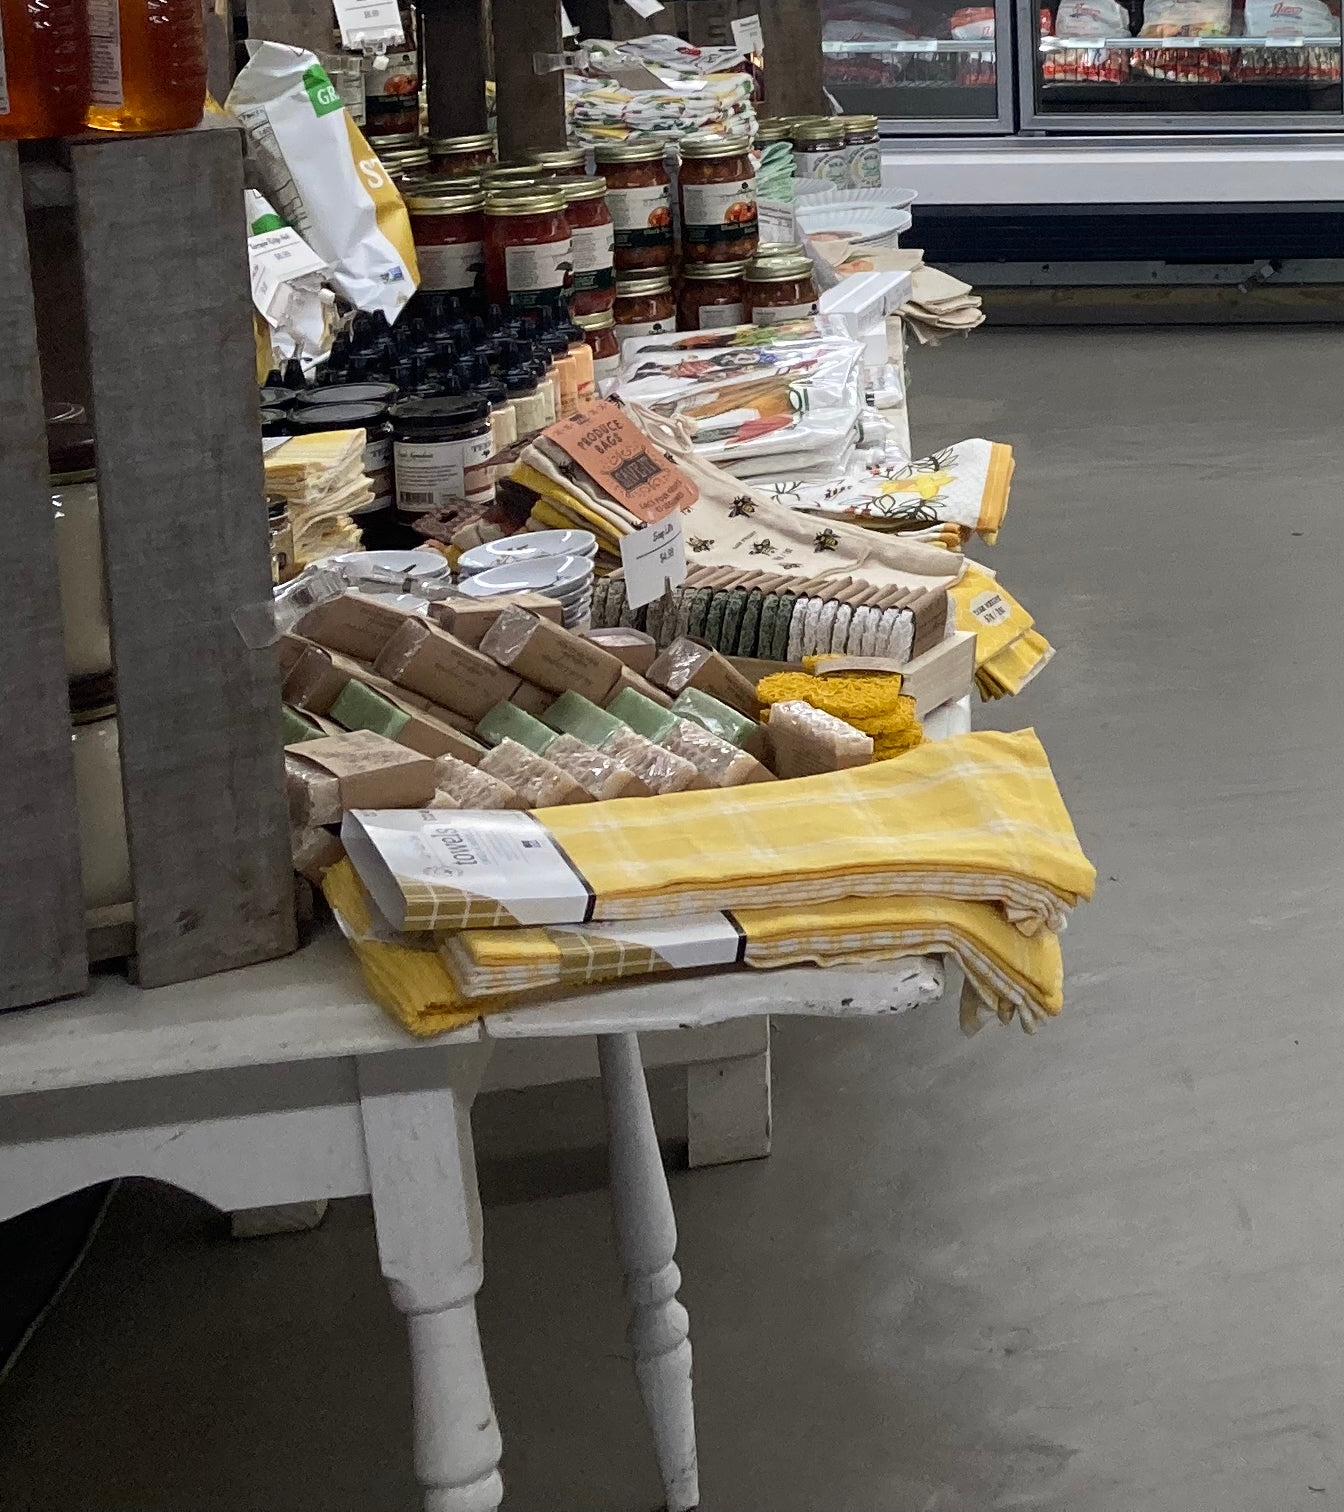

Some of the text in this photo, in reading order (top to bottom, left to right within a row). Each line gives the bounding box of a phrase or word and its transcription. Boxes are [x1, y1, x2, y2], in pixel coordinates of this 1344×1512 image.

[576, 418, 625, 452] PRODUCE
[594, 432, 624, 455] BAGS
[430, 827, 478, 867] towels
